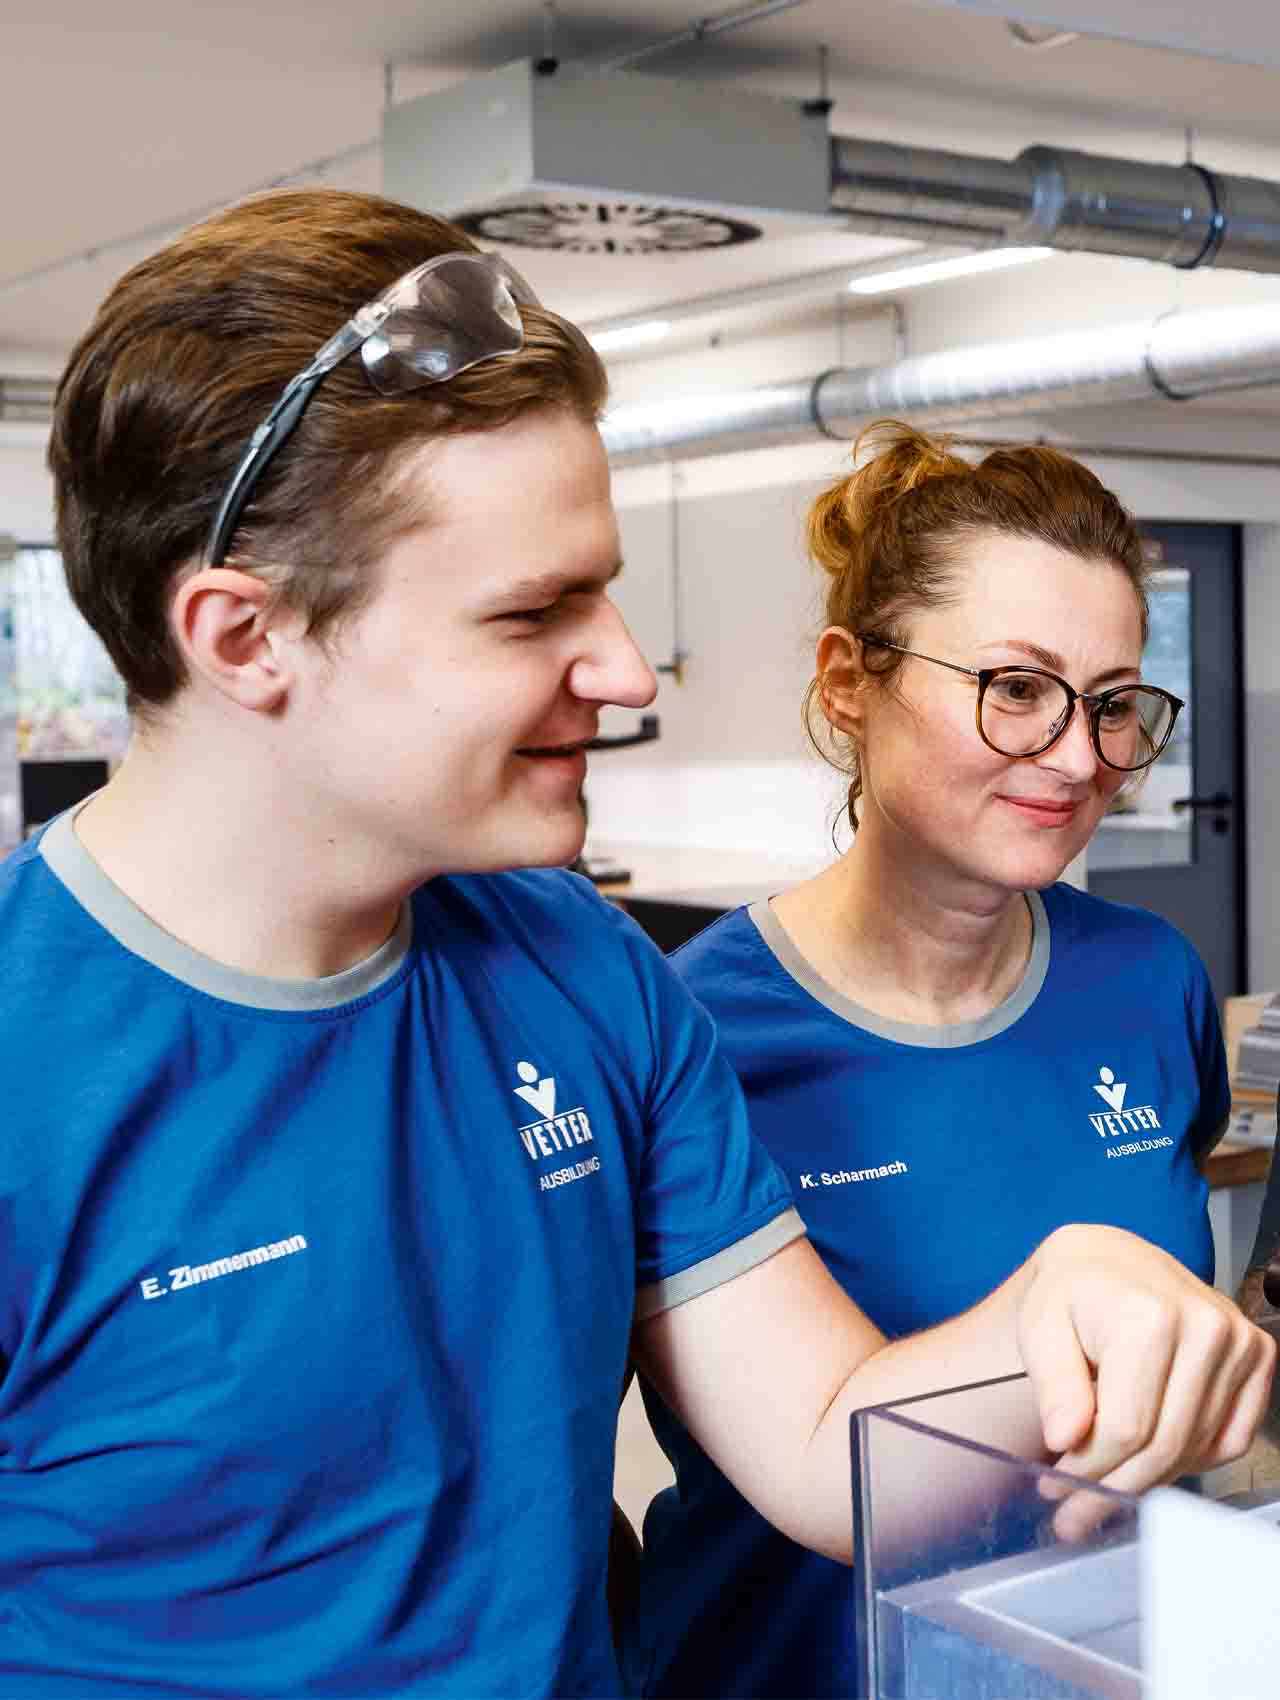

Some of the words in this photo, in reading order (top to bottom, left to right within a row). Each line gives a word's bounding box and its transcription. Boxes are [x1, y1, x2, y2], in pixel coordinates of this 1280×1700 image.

[519, 1111, 593, 1160] VETTER
[1089, 1108, 1161, 1138] VETTER
[1106, 1136, 1174, 1159] AUSBILDUNG
[539, 1156, 601, 1191] AUSBILDUNG
[799, 1173, 820, 1189] K.
[820, 1160, 908, 1186] Scharmach
[140, 1277, 168, 1300] E.
[168, 1234, 308, 1291] Zimmermann
